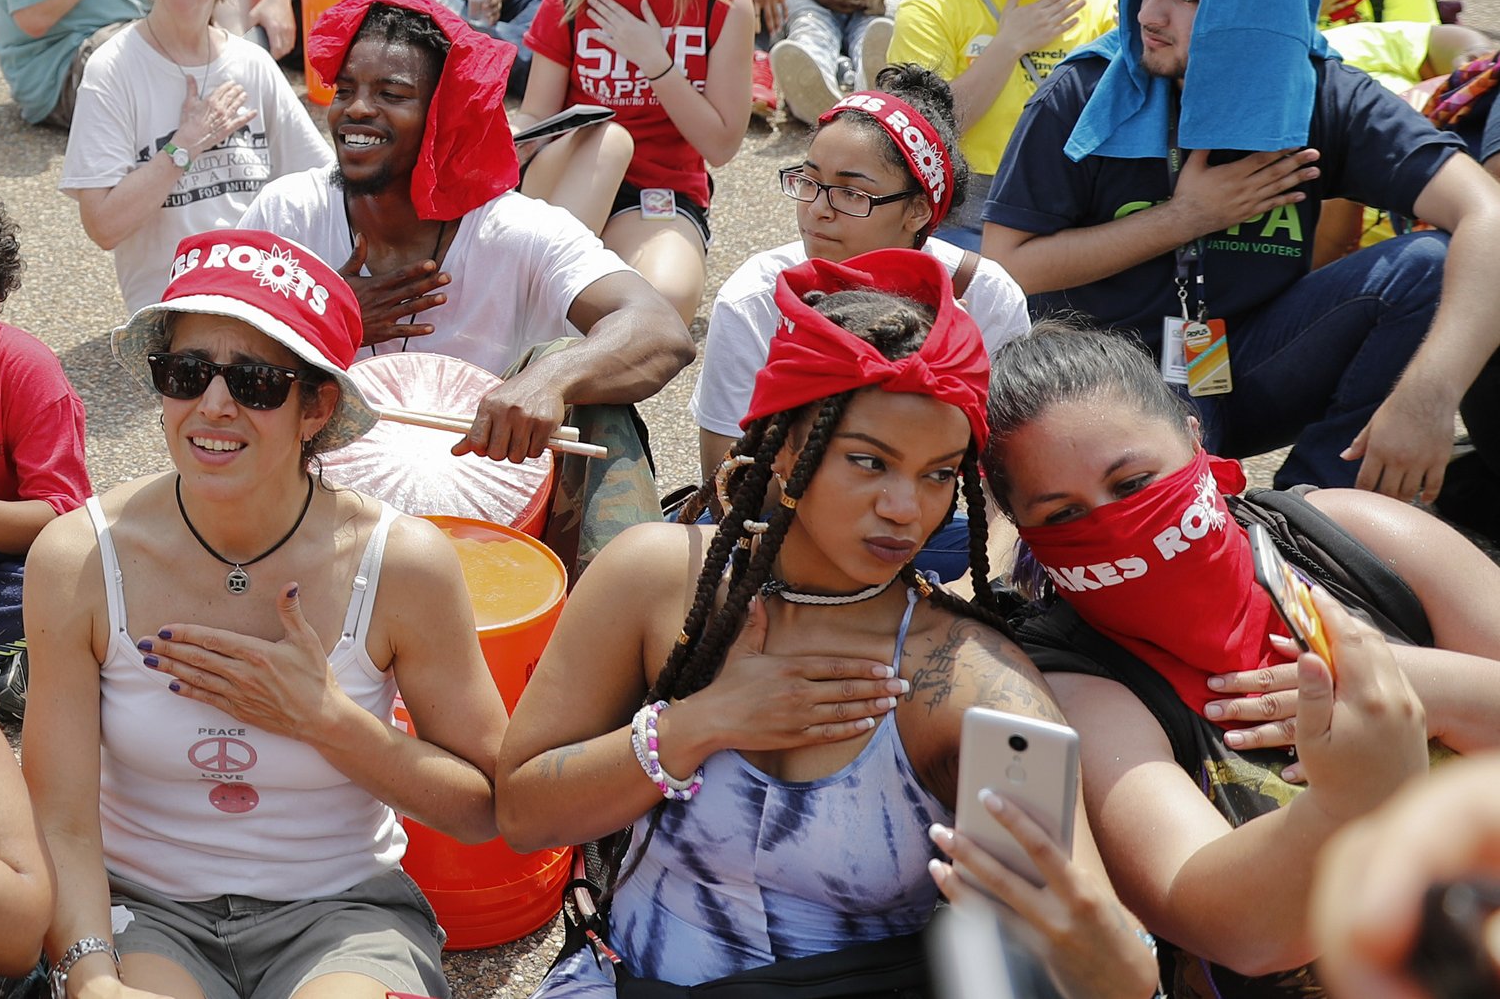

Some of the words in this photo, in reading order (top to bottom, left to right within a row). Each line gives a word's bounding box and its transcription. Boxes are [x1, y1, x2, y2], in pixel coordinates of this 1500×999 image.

[198, 186, 222, 200] FOR
[1252, 243, 1302, 258] VOTERS
[203, 243, 330, 316] ROOTS
[1041, 555, 1149, 592] AKES
[197, 727, 247, 737] PEACE
[201, 772, 245, 781] LOVE
